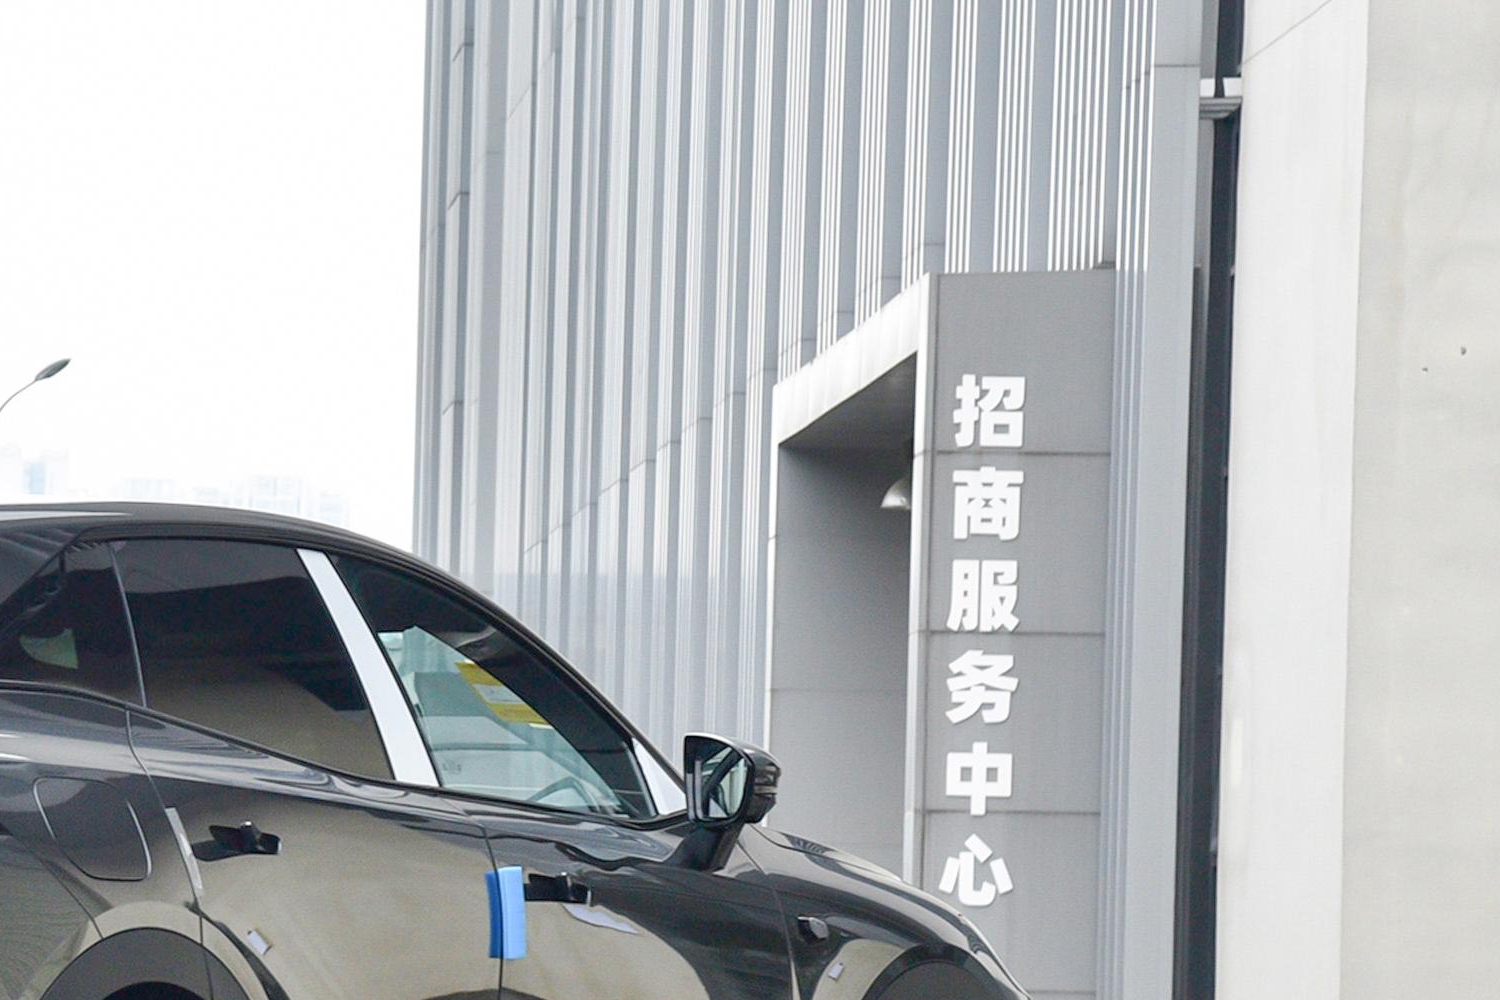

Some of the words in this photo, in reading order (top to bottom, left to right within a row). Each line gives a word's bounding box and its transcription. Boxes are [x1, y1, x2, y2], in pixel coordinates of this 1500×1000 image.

[938, 373, 1027, 907] 招商服务中心
